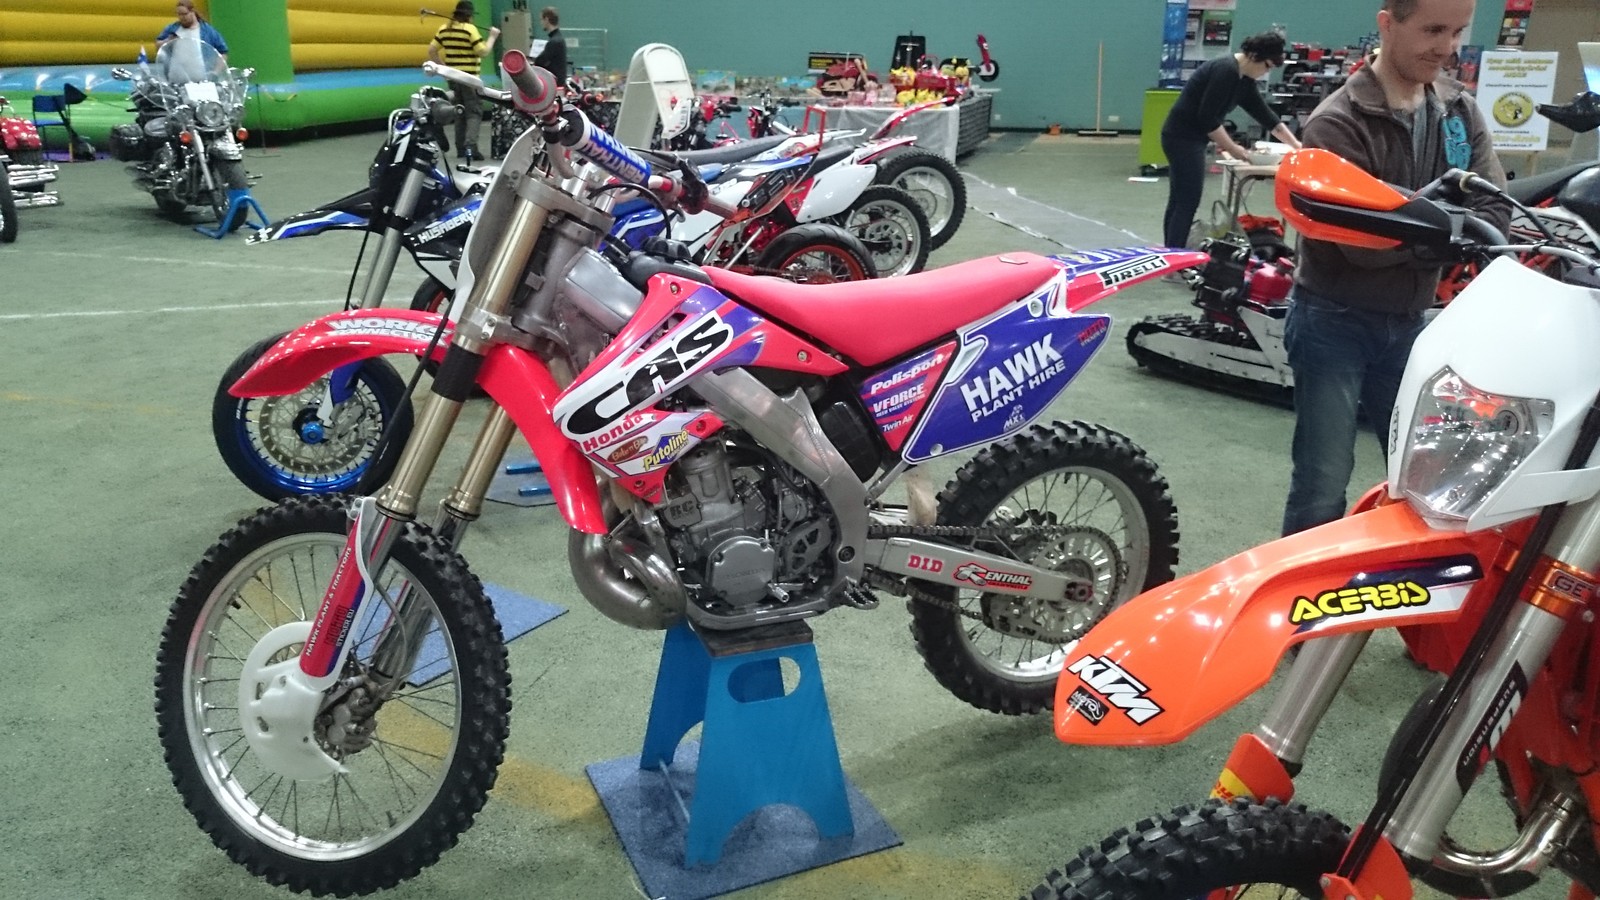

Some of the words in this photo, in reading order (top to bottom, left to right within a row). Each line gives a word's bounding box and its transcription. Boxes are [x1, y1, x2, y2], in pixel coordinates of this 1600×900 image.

[1099, 254, 1168, 287] PIRELLI
[871, 353, 944, 395] Polisport
[960, 332, 1063, 412] HAWK
[971, 384, 1025, 423] PLANT
[1028, 359, 1066, 390] HIRE
[873, 383, 926, 413] VFORCE
[583, 410, 644, 454] Honda
[643, 429, 689, 471] Putoline
[907, 554, 943, 574] DID
[305, 628, 320, 657] HAWK
[317, 600, 331, 629] PLANT
[331, 547, 352, 591] TRACTORS
[1290, 581, 1430, 624] ACERBIS
[1066, 653, 1166, 726] KTM
